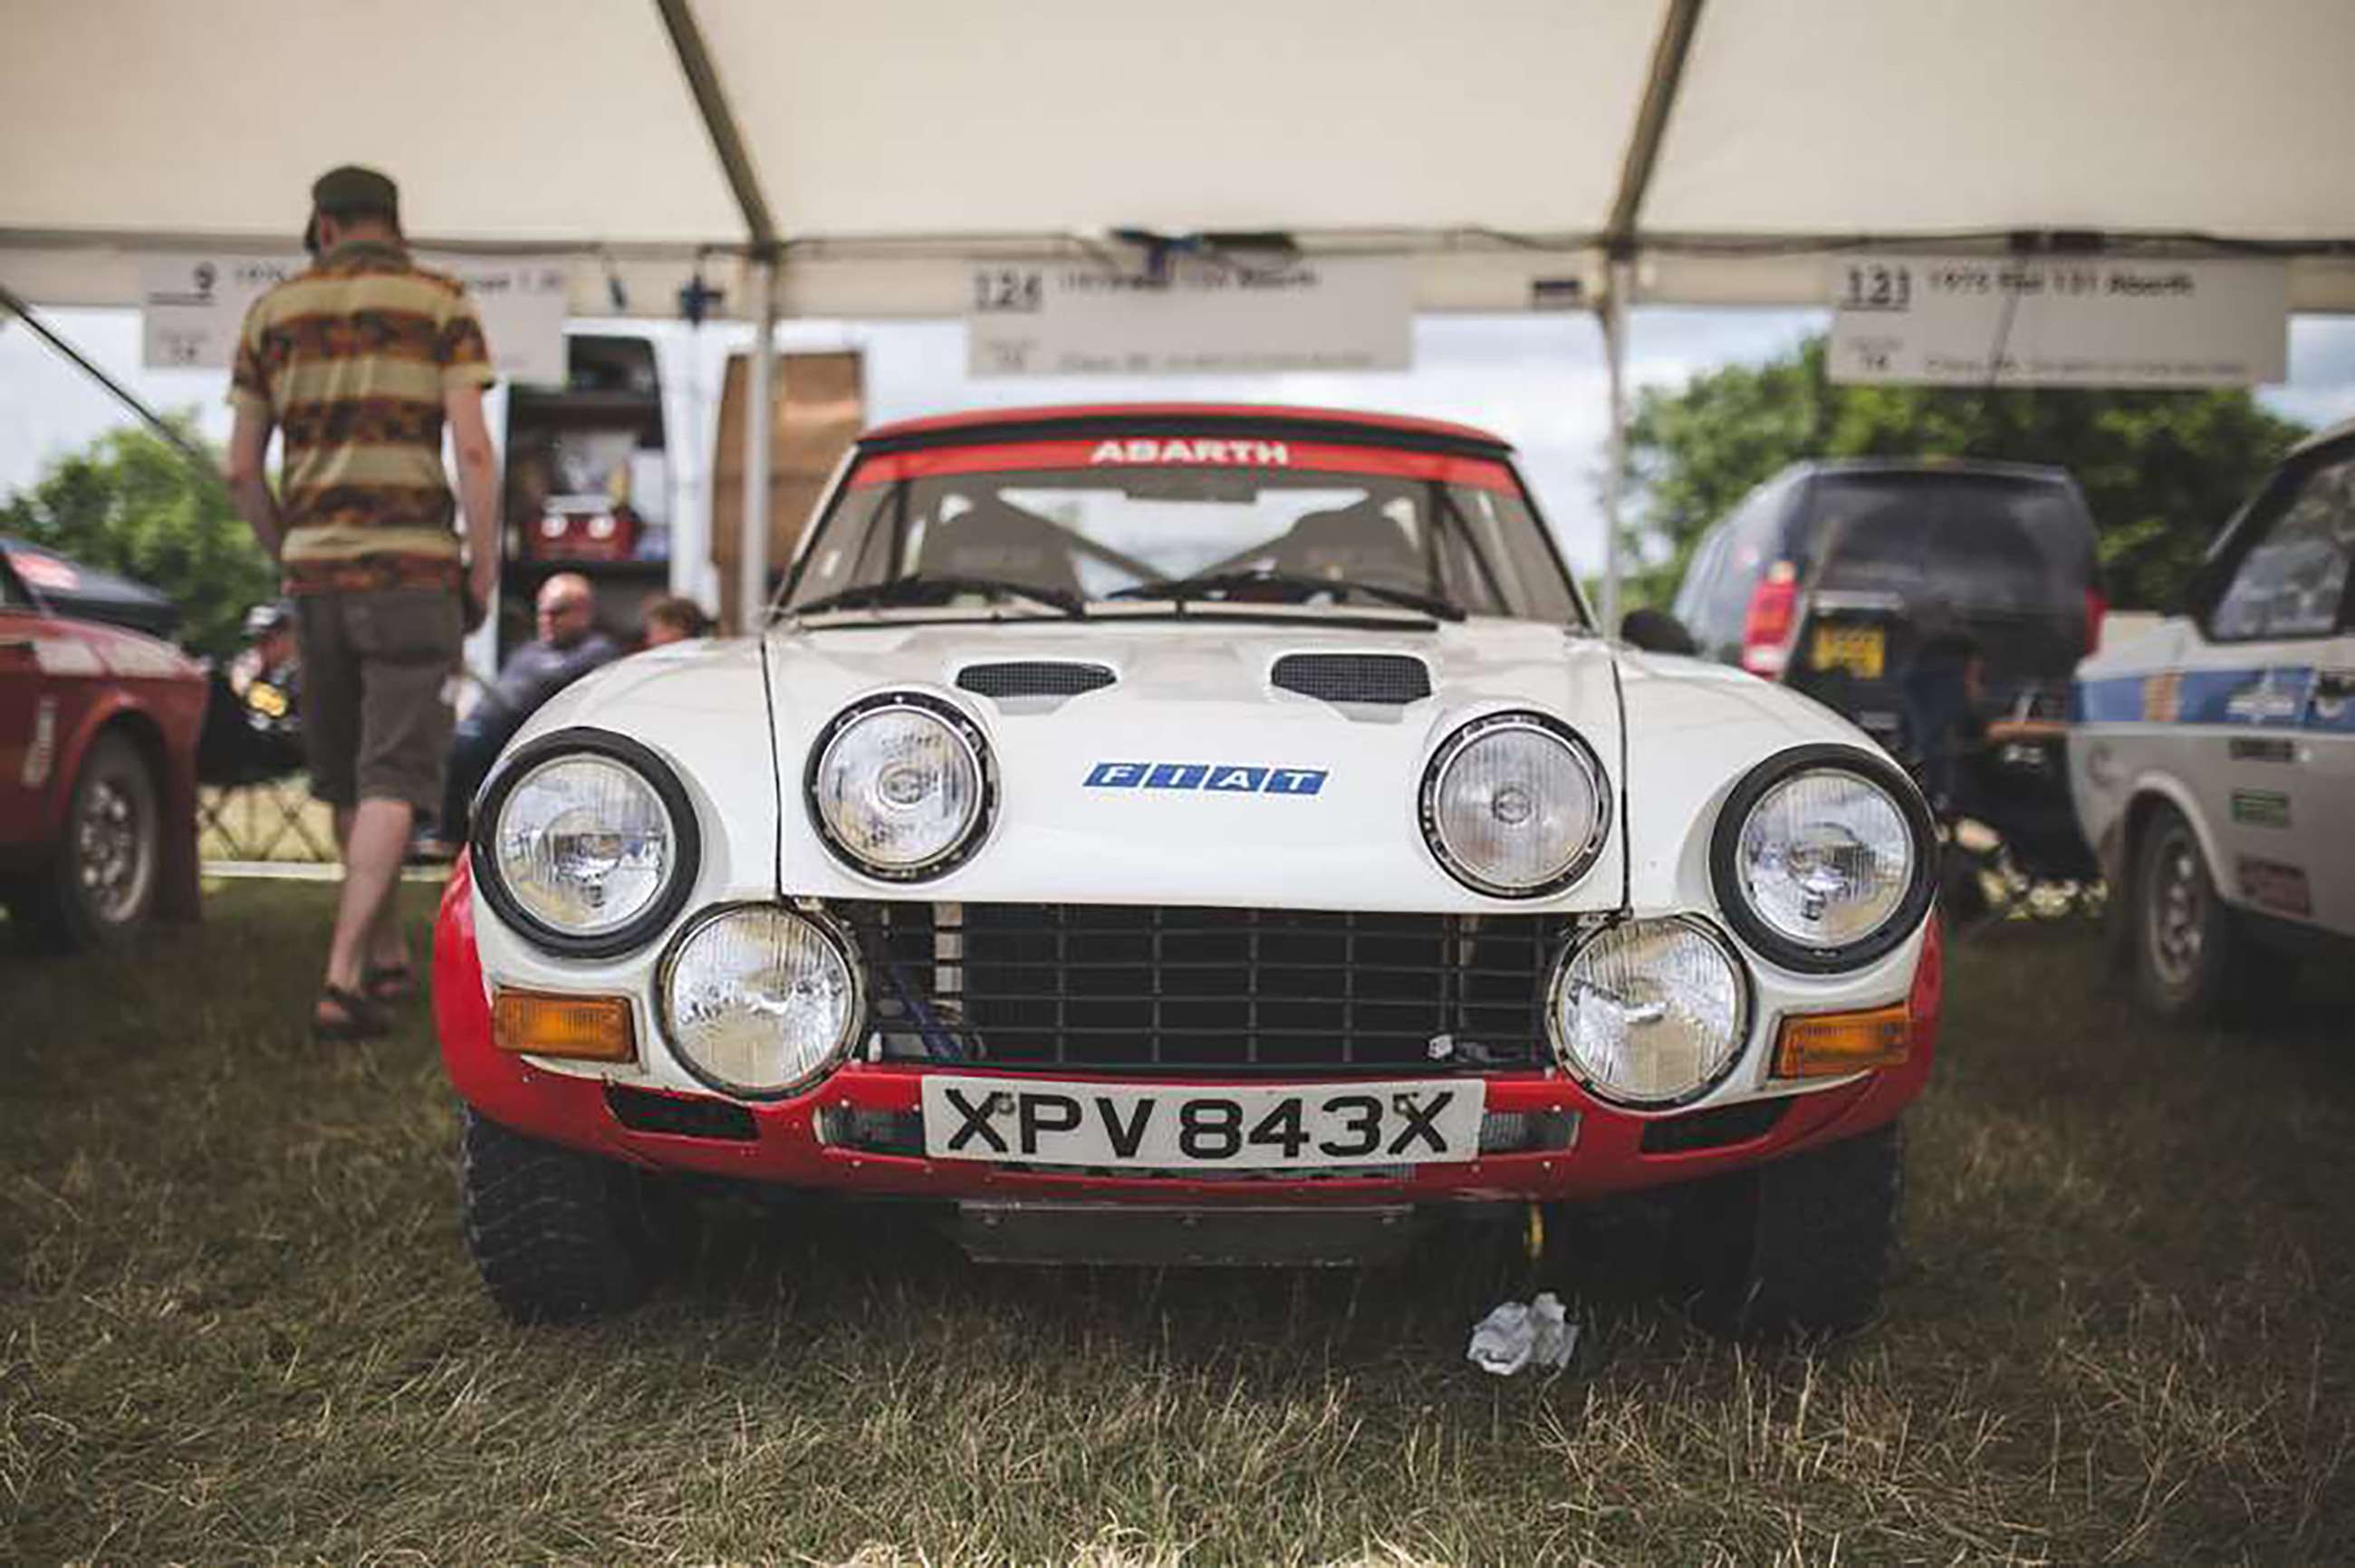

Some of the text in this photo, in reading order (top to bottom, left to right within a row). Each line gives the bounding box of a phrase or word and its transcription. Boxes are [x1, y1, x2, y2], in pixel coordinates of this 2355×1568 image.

[1091, 439, 1288, 465] ABARTH
[1099, 766, 1322, 791] FIAT
[945, 1088, 1454, 1159] XPV 843X
